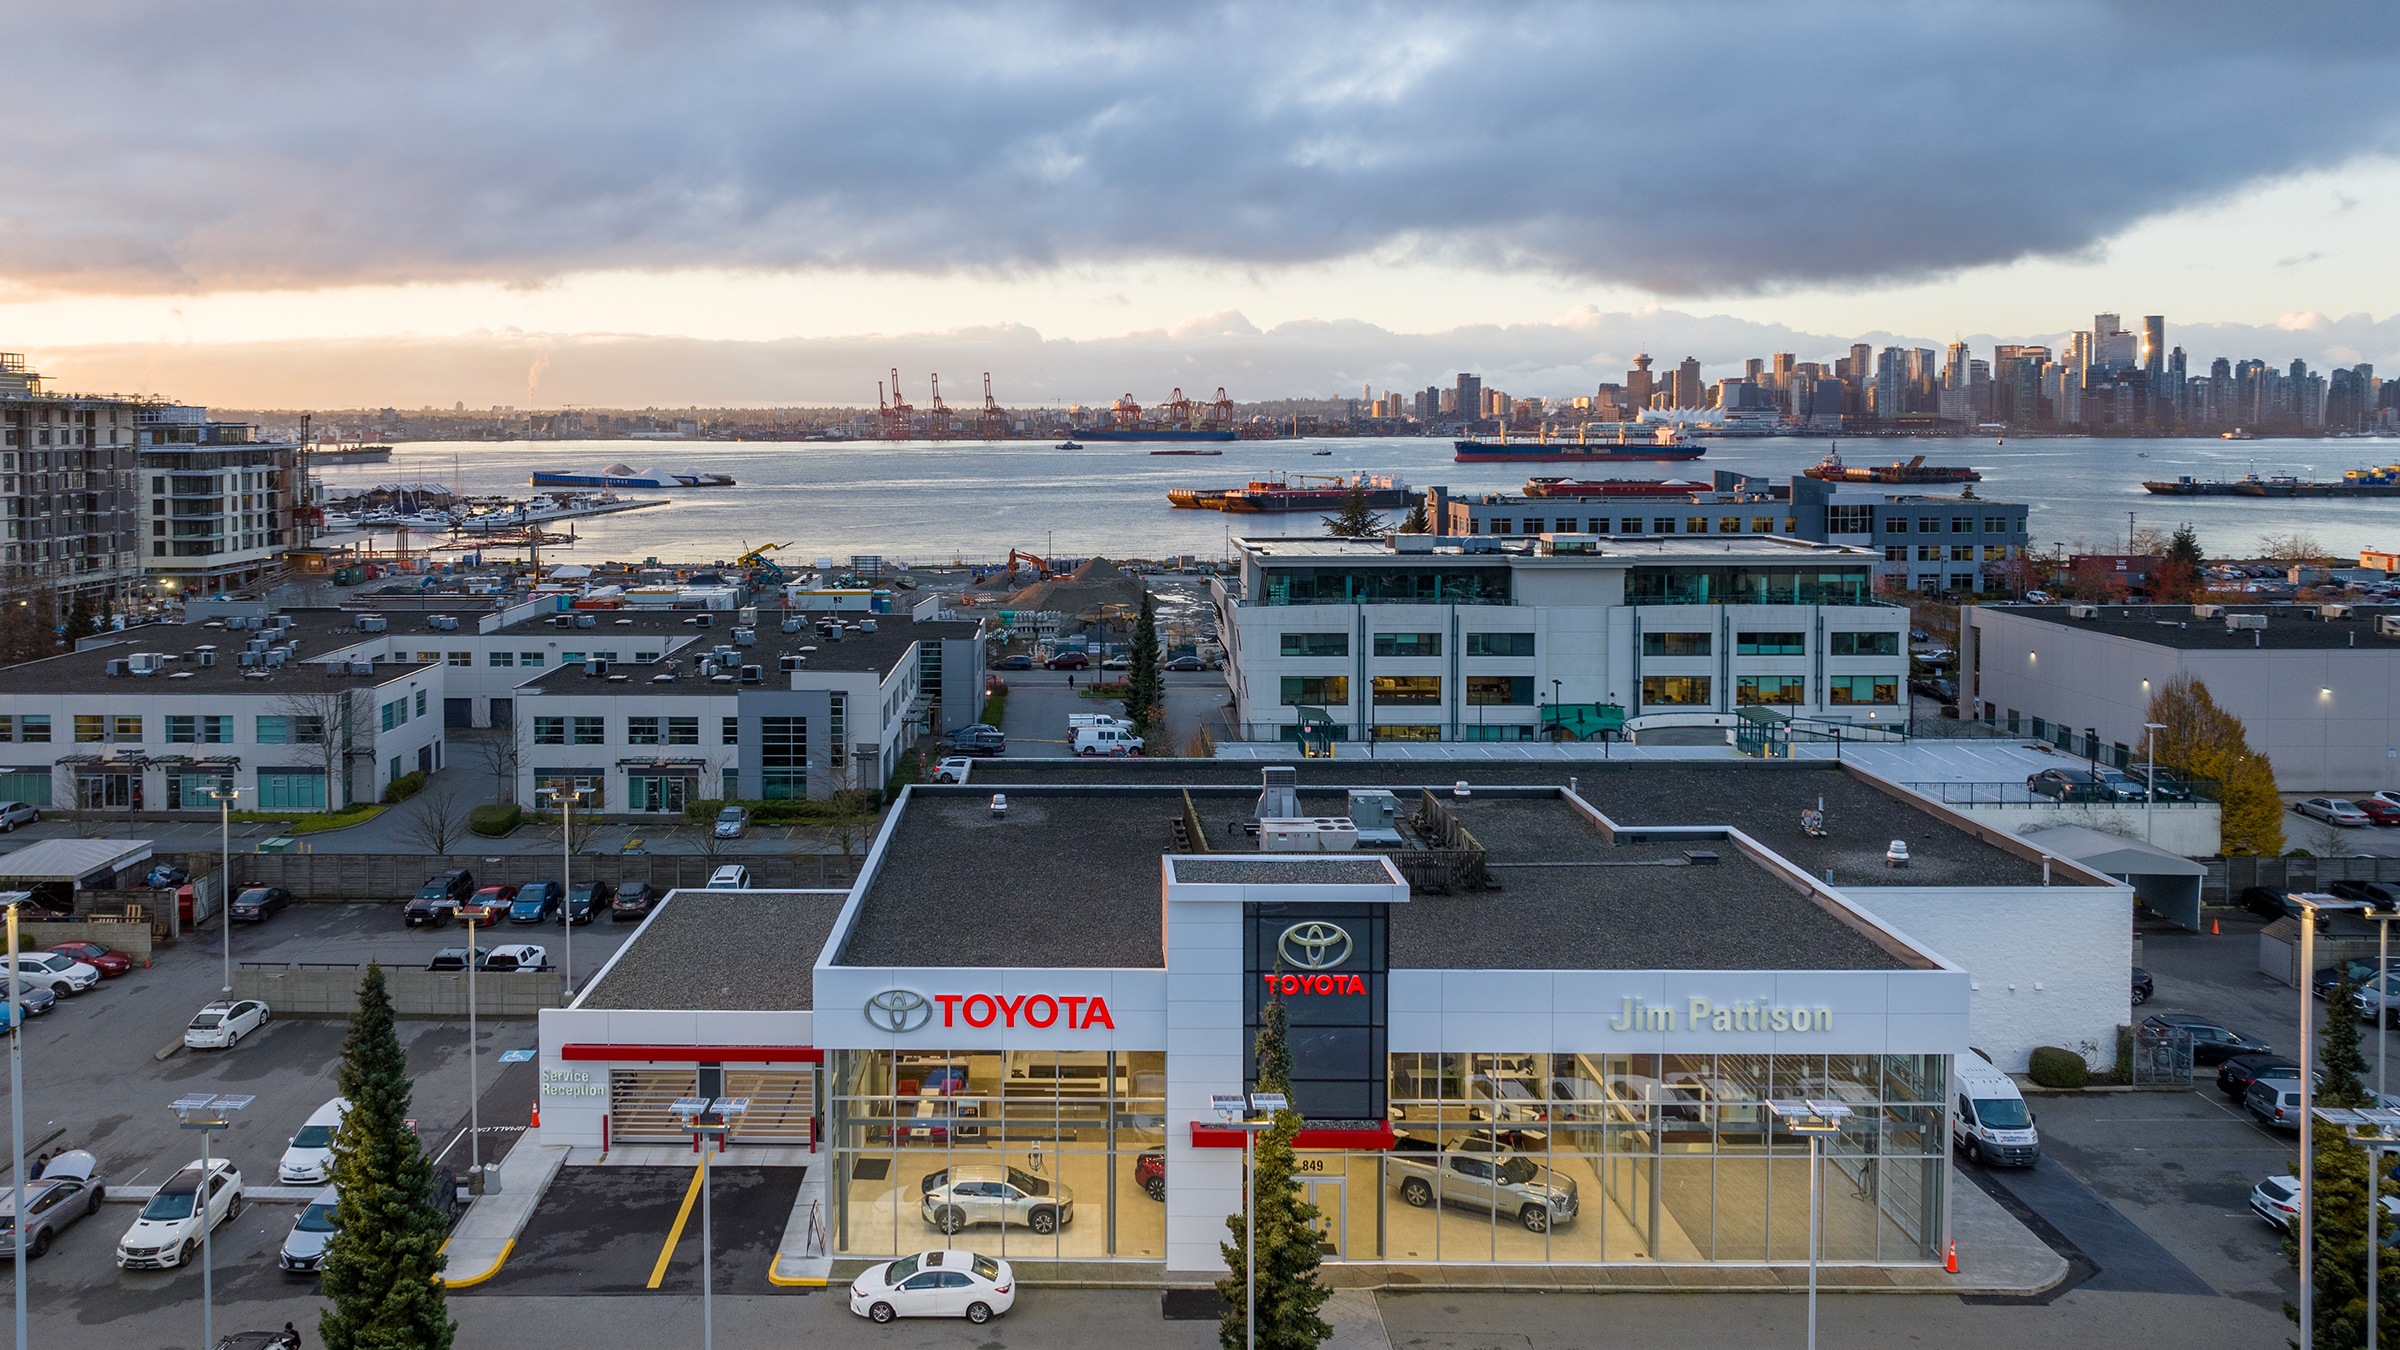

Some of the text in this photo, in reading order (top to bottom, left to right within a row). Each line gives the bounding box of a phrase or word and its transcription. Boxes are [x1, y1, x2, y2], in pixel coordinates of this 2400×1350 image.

[1264, 974, 1366, 995] TOYOTA
[934, 993, 1115, 1029] TOYOTA
[1610, 996, 1833, 1032] Jim Pattison
[542, 1069, 589, 1081] Service
[542, 1082, 605, 1098] Reception
[1302, 1160, 1323, 1171] 849
